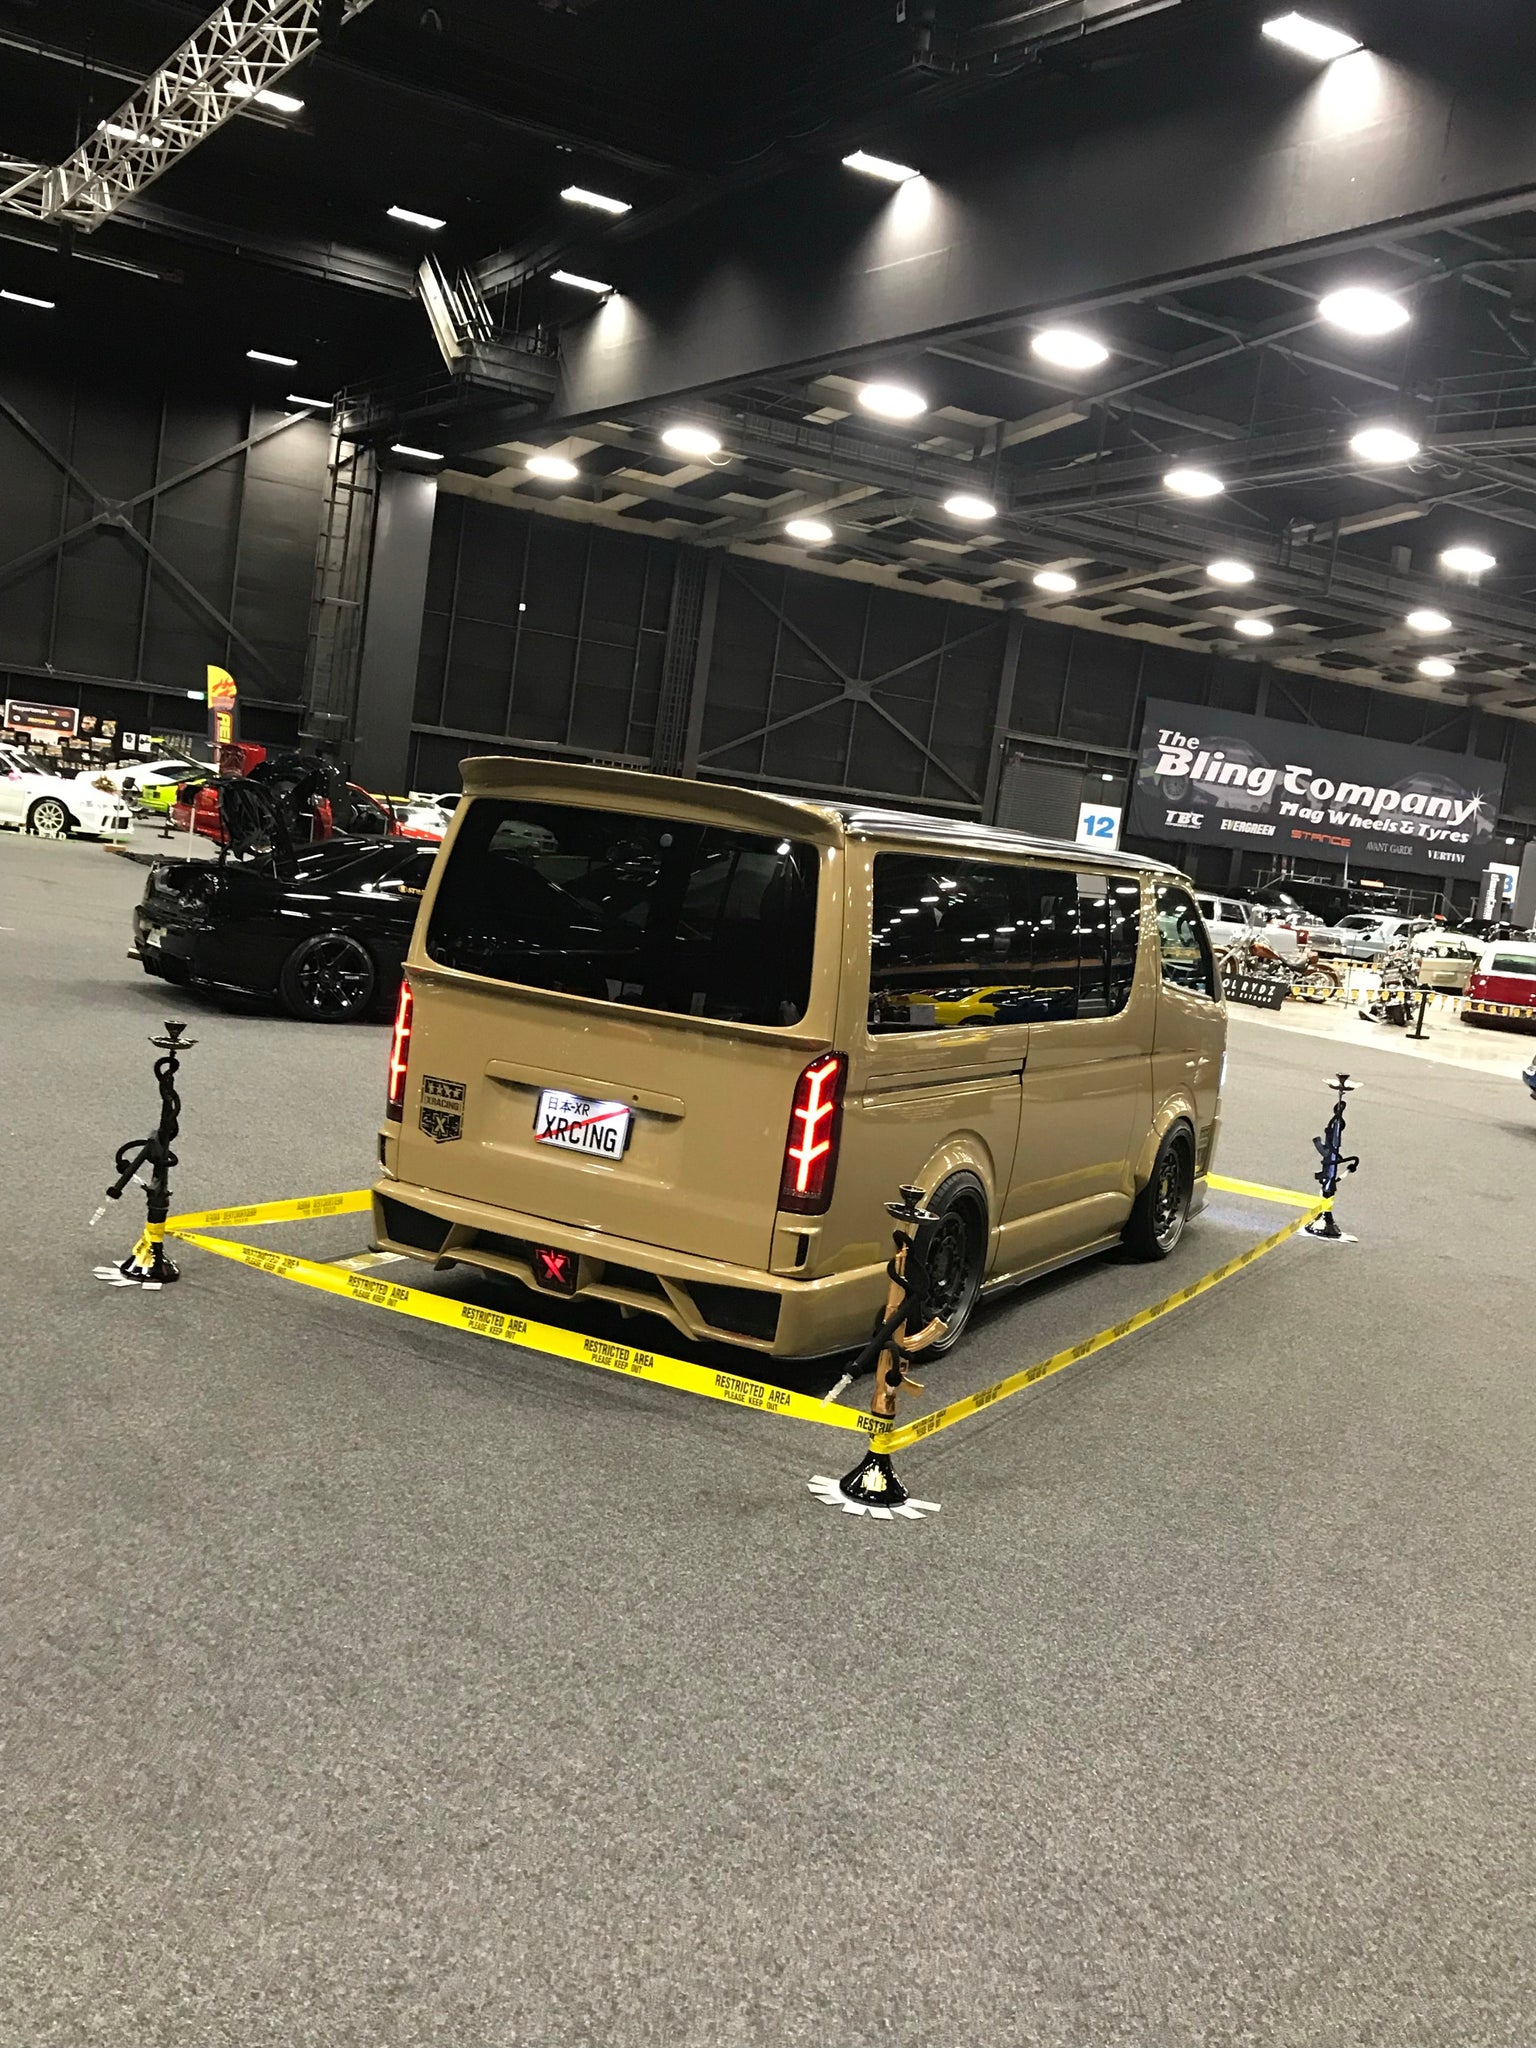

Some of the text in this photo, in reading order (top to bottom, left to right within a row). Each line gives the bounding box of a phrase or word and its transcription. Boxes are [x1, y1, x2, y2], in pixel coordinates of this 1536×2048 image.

[1158, 729, 1200, 750] The
[1154, 744, 1476, 826] Bling Company
[1083, 815, 1115, 838] 12
[1220, 819, 1276, 836] EVERGREEN
[1279, 801, 1324, 823] Mag
[1328, 809, 1399, 833] Wheels
[1418, 823, 1470, 844] Tyres
[1291, 829, 1352, 848] STANCE
[1366, 841, 1413, 855] AVANT GARDE
[1241, 981, 1276, 996] RYDZ
[548, 1096, 590, 1117] 日本-XR
[543, 1113, 618, 1153] XRCING
[347, 1275, 409, 1301] RESTRICTED AREA
[461, 1306, 527, 1334] RESTRICTED AREA
[468, 1320, 516, 1339] PLEASE KEEP OUT
[584, 1338, 654, 1368] RESTRICTED AREA
[591, 1353, 643, 1374] PLEASE KEEP OUT
[715, 1374, 791, 1406] RESTRICTED AREA
[724, 1389, 778, 1411] PLEASE KEEP OUT
